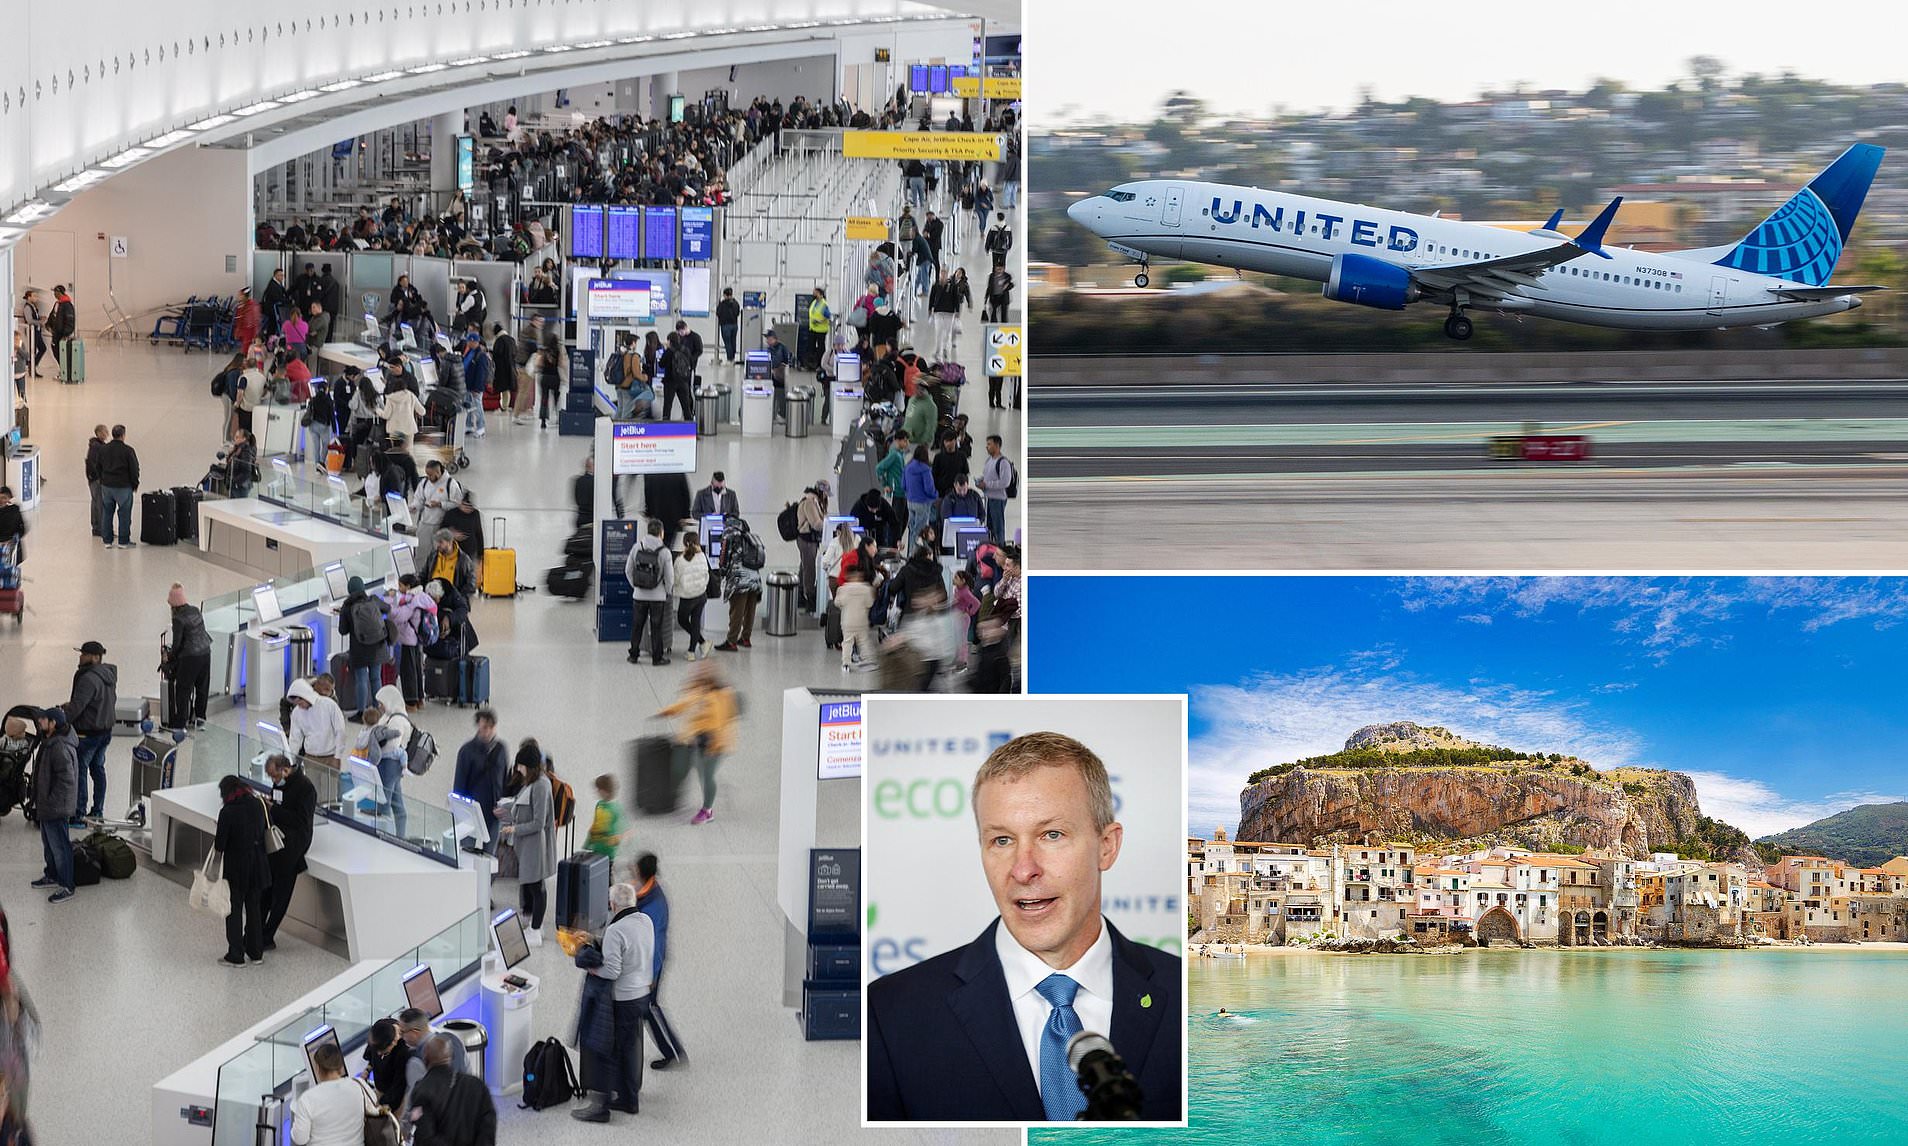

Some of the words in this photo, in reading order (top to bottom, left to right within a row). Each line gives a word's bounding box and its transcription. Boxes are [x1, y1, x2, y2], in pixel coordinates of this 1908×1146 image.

[892, 147, 915, 155] Priority
[917, 147, 942, 155] Security
[1211, 197, 1419, 252] UNITED
[1636, 266, 1668, 277] N37308
[620, 425, 645, 437] jetBlue
[828, 703, 861, 720] jetBlu
[828, 730, 856, 742] Start
[872, 736, 979, 756] UNITED
[874, 777, 965, 820] eco
